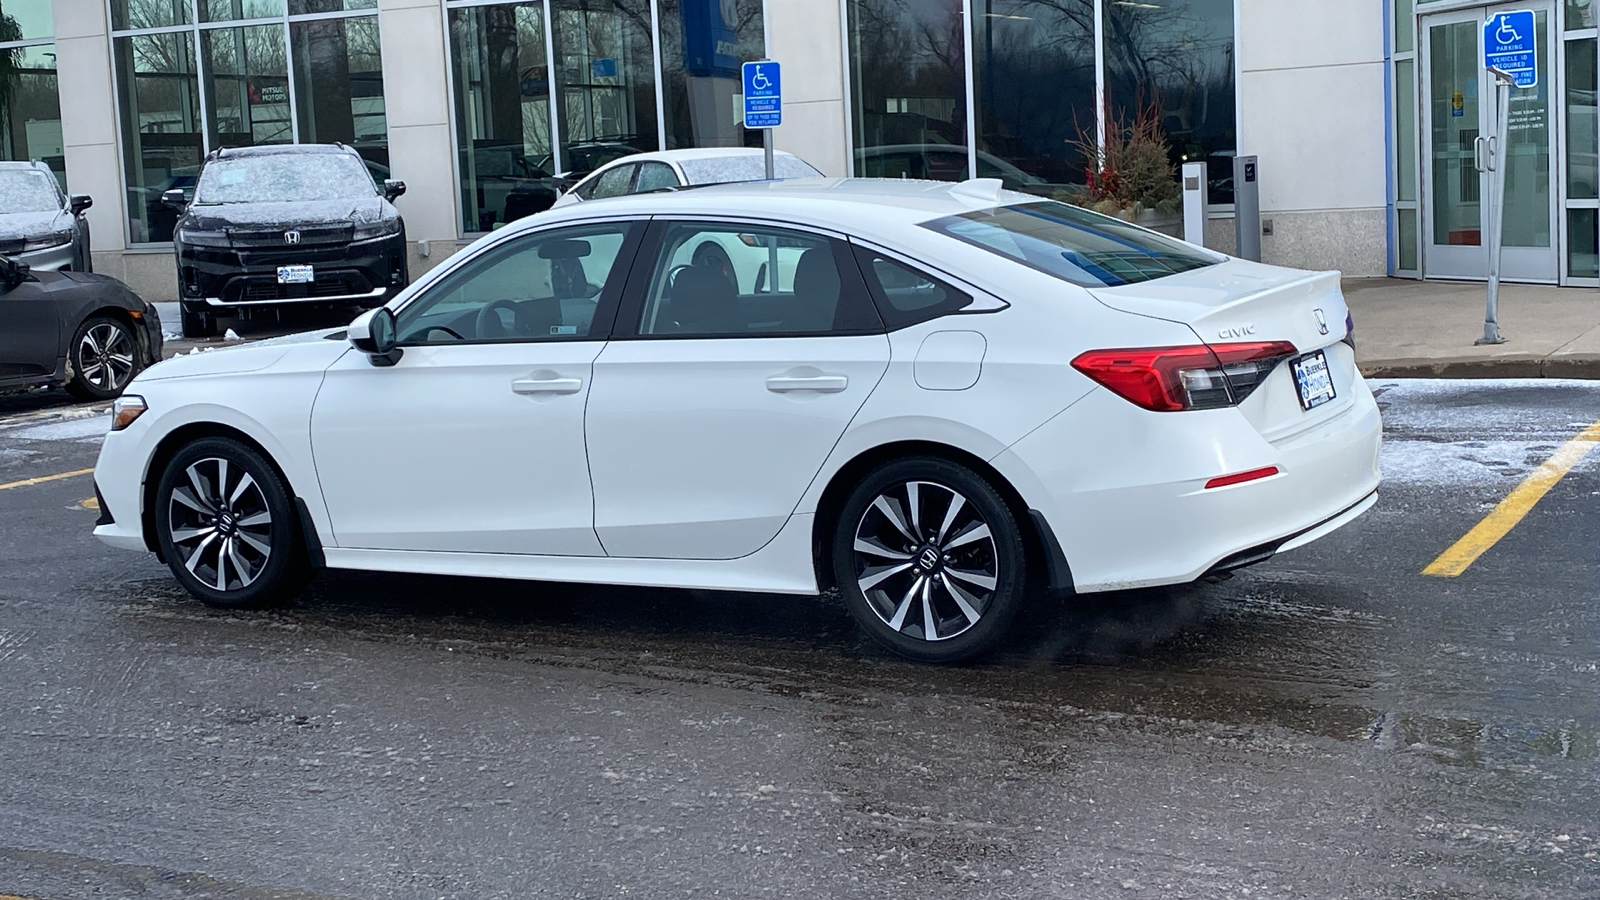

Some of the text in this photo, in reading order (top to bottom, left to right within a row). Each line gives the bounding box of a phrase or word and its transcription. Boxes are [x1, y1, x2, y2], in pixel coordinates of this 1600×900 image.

[1219, 325, 1255, 339] CIVIC
[1305, 361, 1327, 376] BUERKLE
[1308, 374, 1330, 393] HONDA
